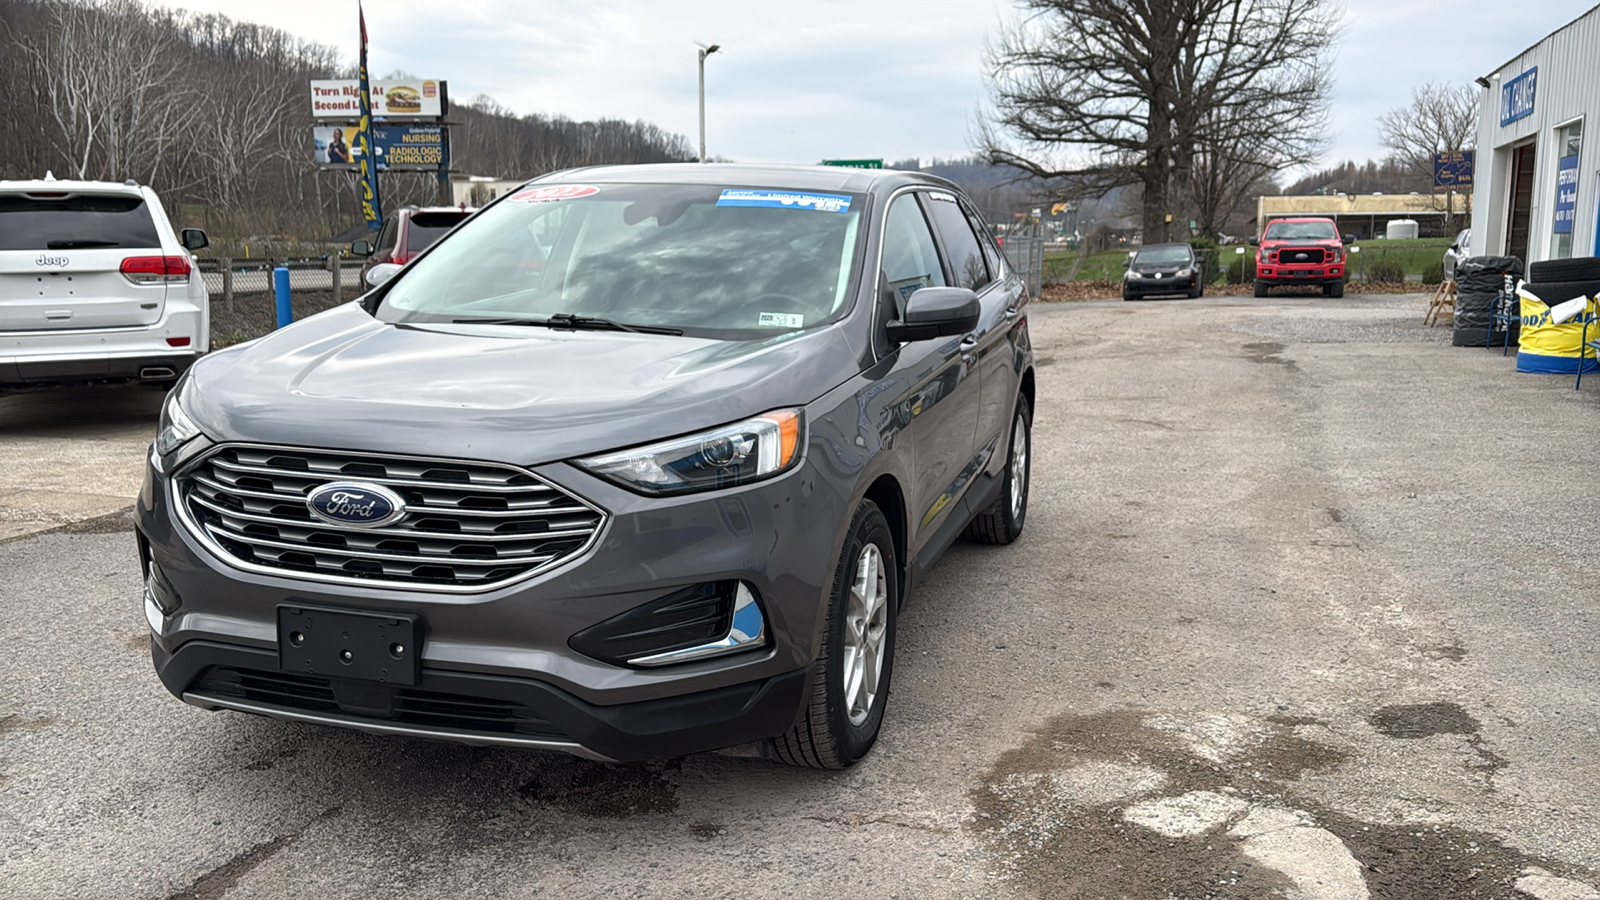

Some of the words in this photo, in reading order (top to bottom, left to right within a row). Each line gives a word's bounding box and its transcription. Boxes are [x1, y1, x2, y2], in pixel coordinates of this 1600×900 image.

[313, 86, 340, 97] Turn
[342, 85, 361, 98] Rig
[372, 86, 384, 96] At
[1511, 72, 1536, 117] CHANGE
[314, 100, 351, 111] Second
[402, 133, 441, 144] NURSING
[389, 146, 442, 156] RADIOLOGIC
[383, 154, 442, 164] TECHNOLOGY
[767, 192, 800, 200] Limited
[802, 194, 845, 204] Warranty
[35, 254, 70, 267] Jeep
[790, 317, 797, 325] 3
[326, 491, 377, 517] Ford
